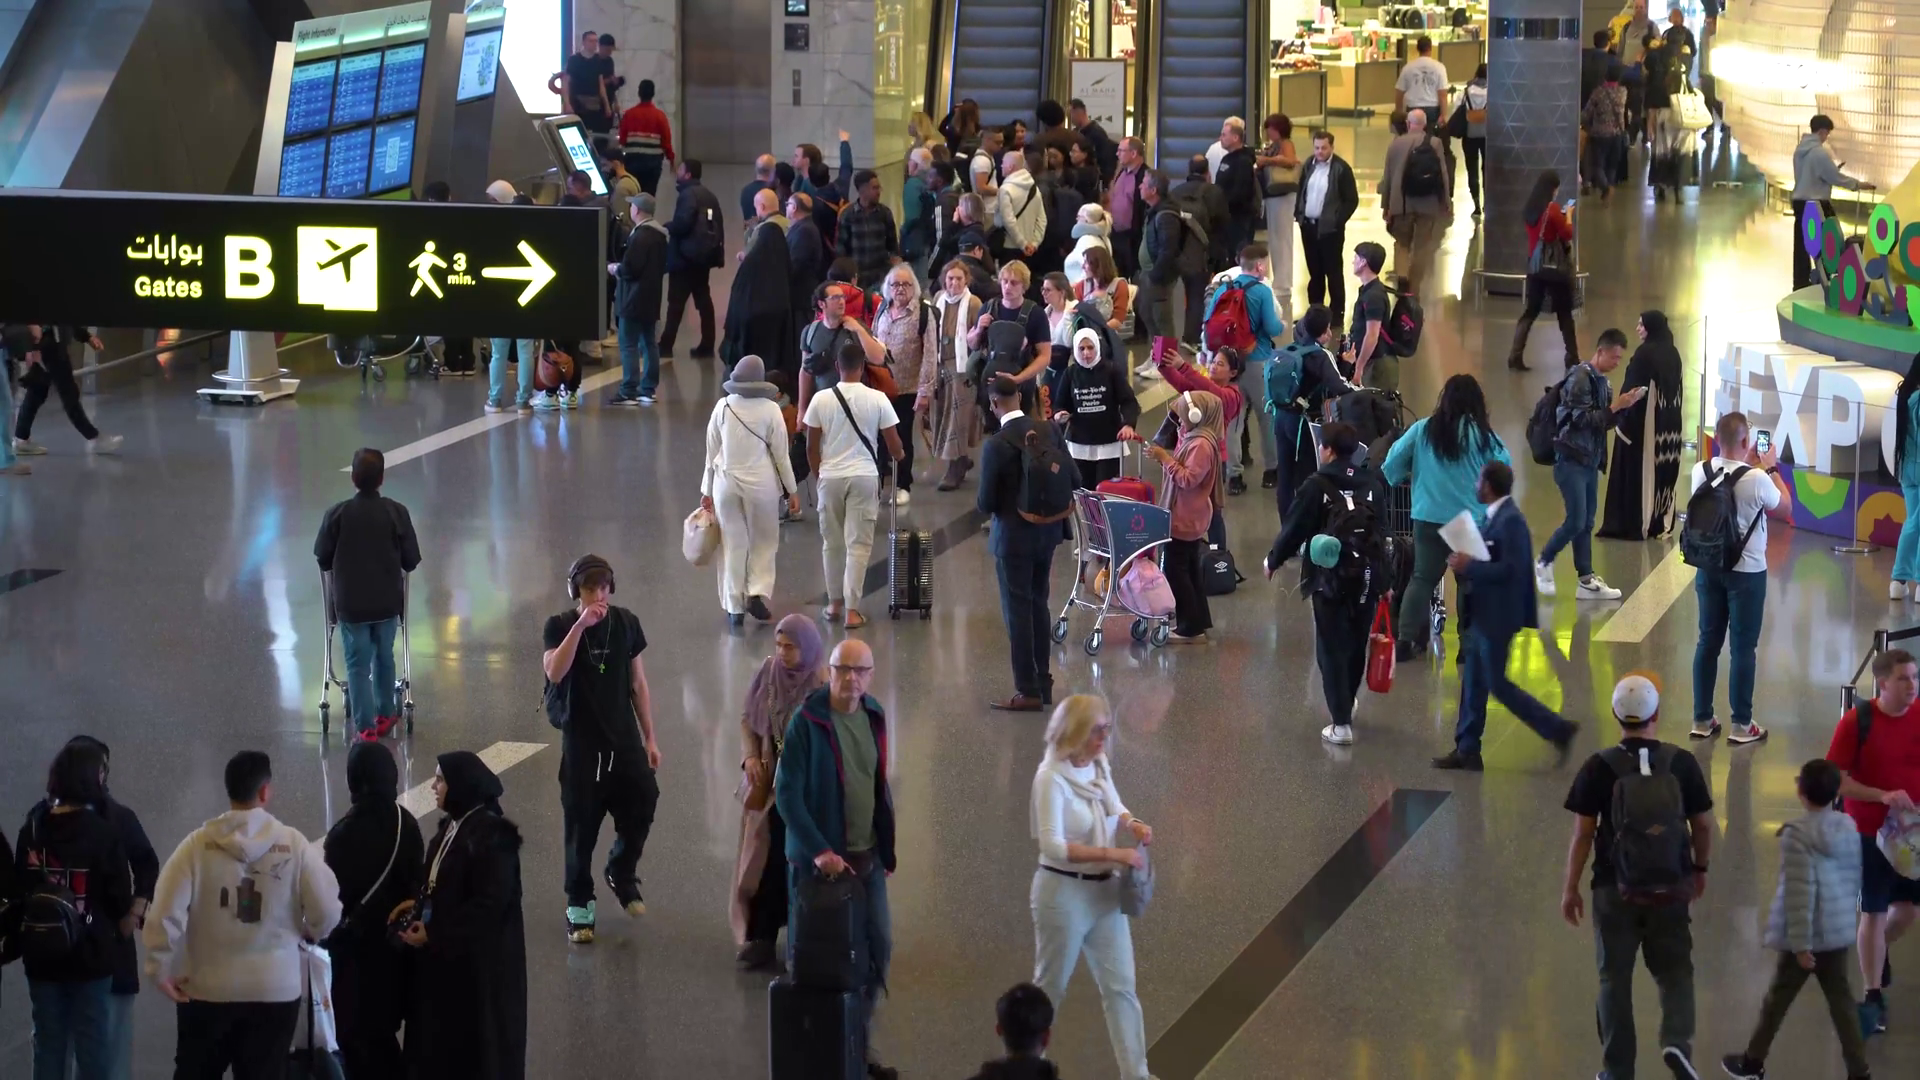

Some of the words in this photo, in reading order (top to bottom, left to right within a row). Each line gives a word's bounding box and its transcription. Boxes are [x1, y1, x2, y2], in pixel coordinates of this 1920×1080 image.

[297, 28, 311, 43] Flight
[312, 27, 337, 39] Information
[127, 234, 203, 267] بوابات
[224, 235, 275, 300] B
[453, 253, 467, 271] 3
[134, 275, 203, 299] Gates
[447, 271, 476, 286] min.
